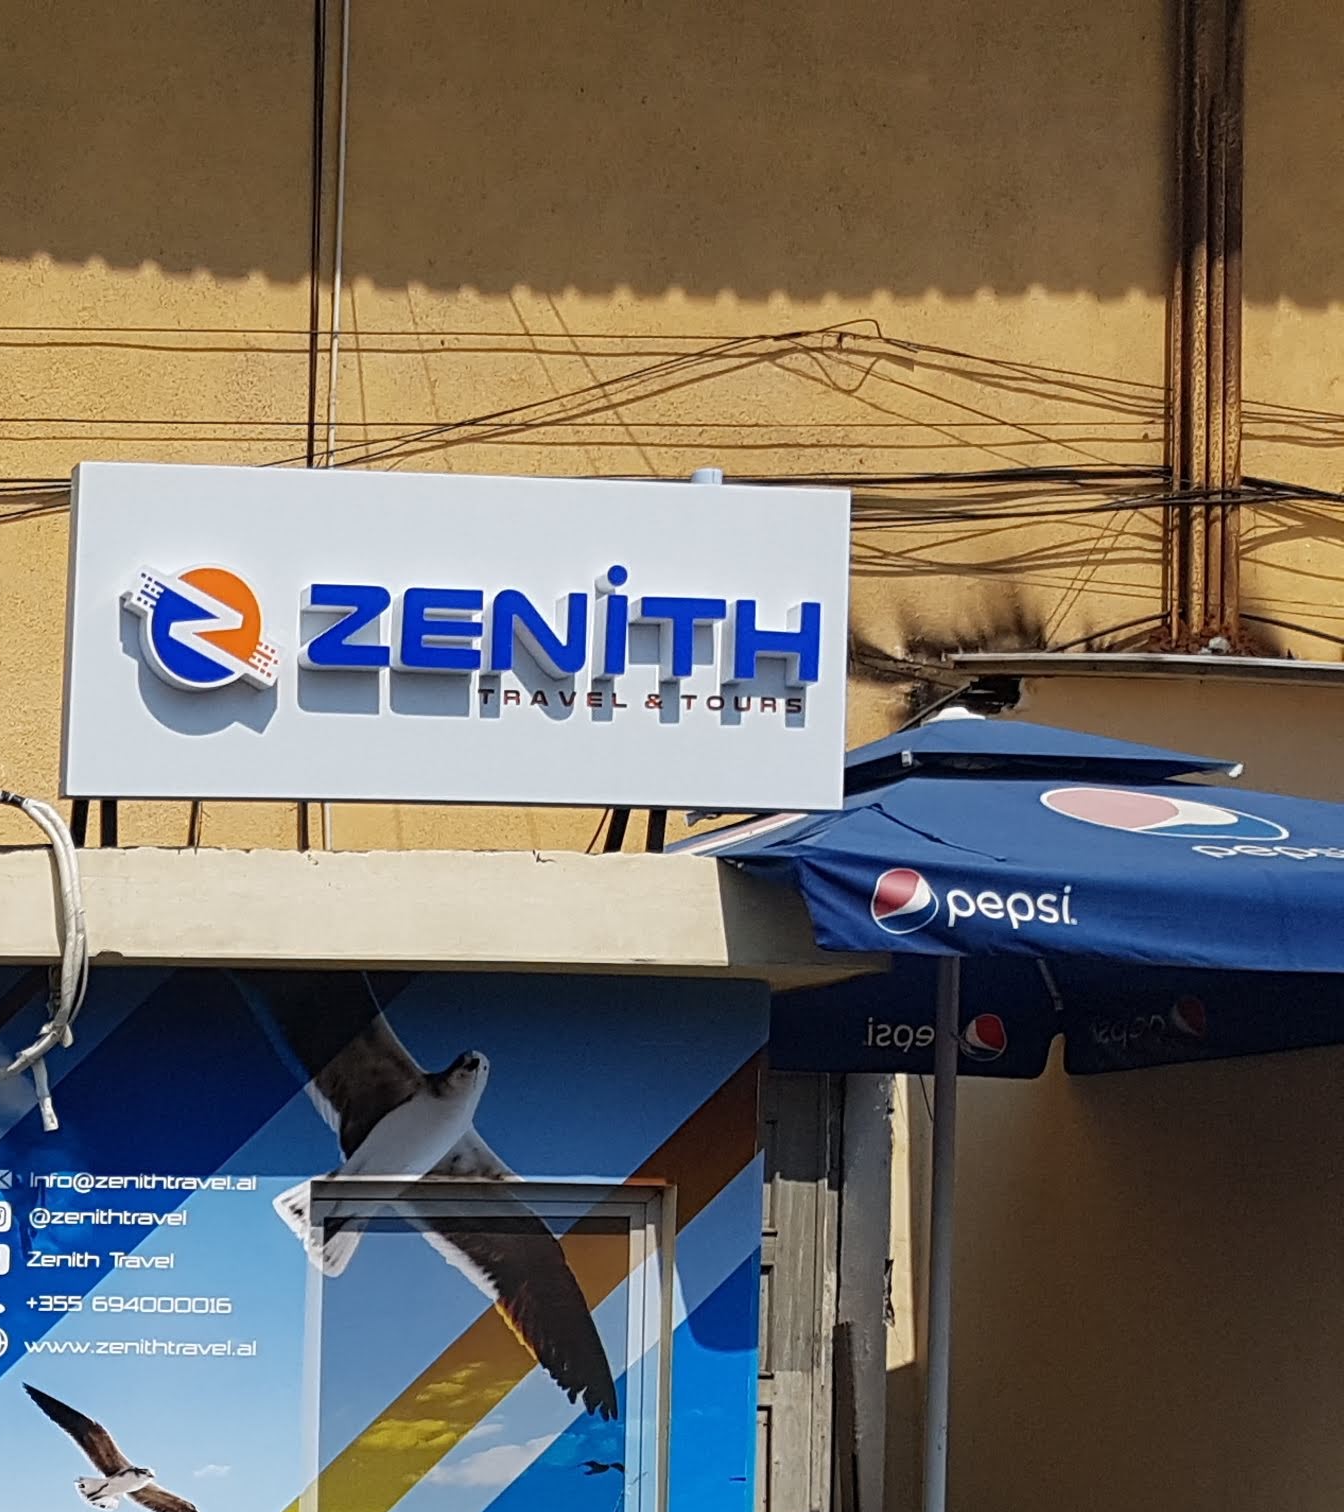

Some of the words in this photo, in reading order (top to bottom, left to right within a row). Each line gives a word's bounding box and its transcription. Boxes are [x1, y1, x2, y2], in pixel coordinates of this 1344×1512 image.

[478, 687, 627, 710] TRAVEL
[645, 692, 664, 710] &
[681, 693, 804, 714] TOURS
[945, 884, 1077, 930] pepsi
[28, 1207, 187, 1229] @zenithtravel
[26, 1251, 100, 1268] Zenith
[109, 1251, 175, 1269] Travel
[25, 1295, 83, 1312] +355
[91, 1296, 232, 1315] 694000016
[23, 1338, 258, 1357] www.zenithtravel.al
